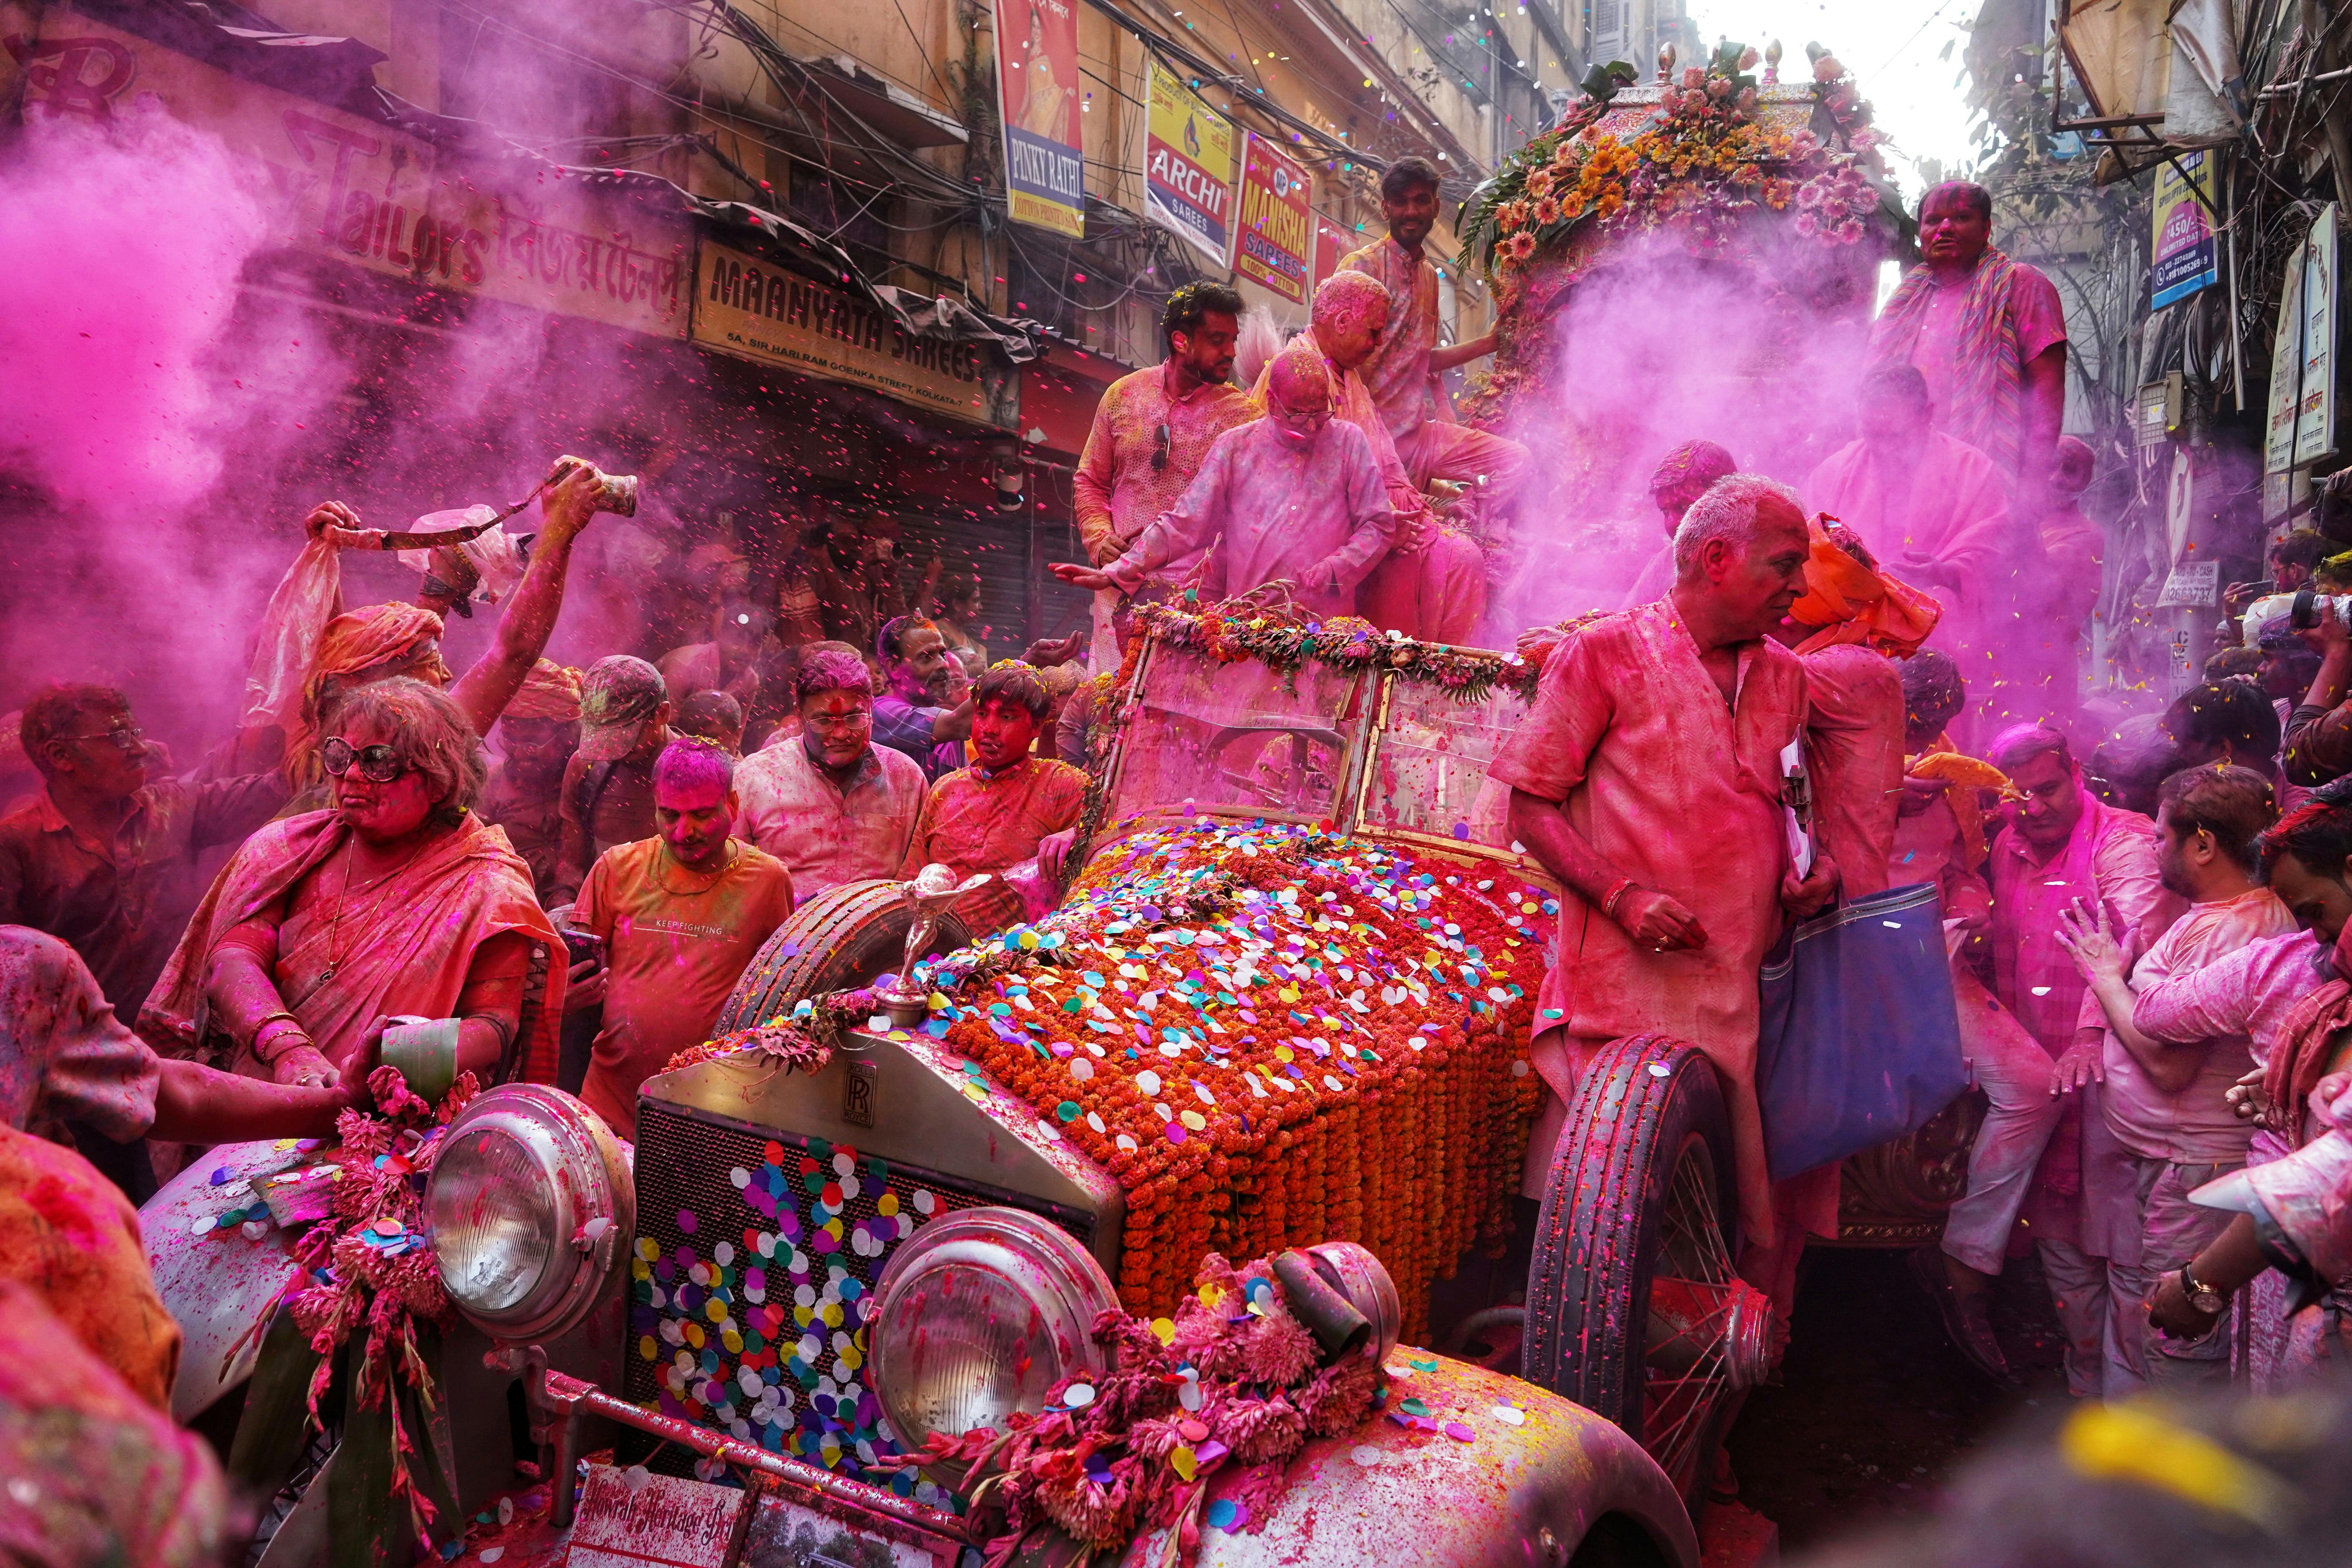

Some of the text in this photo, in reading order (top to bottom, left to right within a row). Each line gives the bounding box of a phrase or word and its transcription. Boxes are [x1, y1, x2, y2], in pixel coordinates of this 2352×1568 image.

[1011, 138, 1081, 199] PINKY RATHI
[1150, 148, 1222, 215] ARCHI
[1172, 198, 1207, 232] SAREES
[1242, 177, 1306, 260] MANISHA
[1245, 232, 1300, 279] SAREES
[2160, 239, 2186, 257] UNLIMITED
[1247, 259, 1267, 279] 100%
[710, 256, 884, 354] MAANYATA
[727, 332, 745, 346] 5A,
[749, 338, 769, 350] SIR
[771, 345, 799, 359] HARI
[802, 353, 827, 367] RAM
[830, 362, 875, 382] GOENKA
[878, 375, 914, 394] STREET,
[2200, 566, 2213, 576] CASH
[656, 919, 722, 935] KEEP FIGHTING
[849, 1064, 873, 1076] ROLLS
[844, 1111, 869, 1123] ROYCE
[635, 1487, 705, 1541] Heritage
